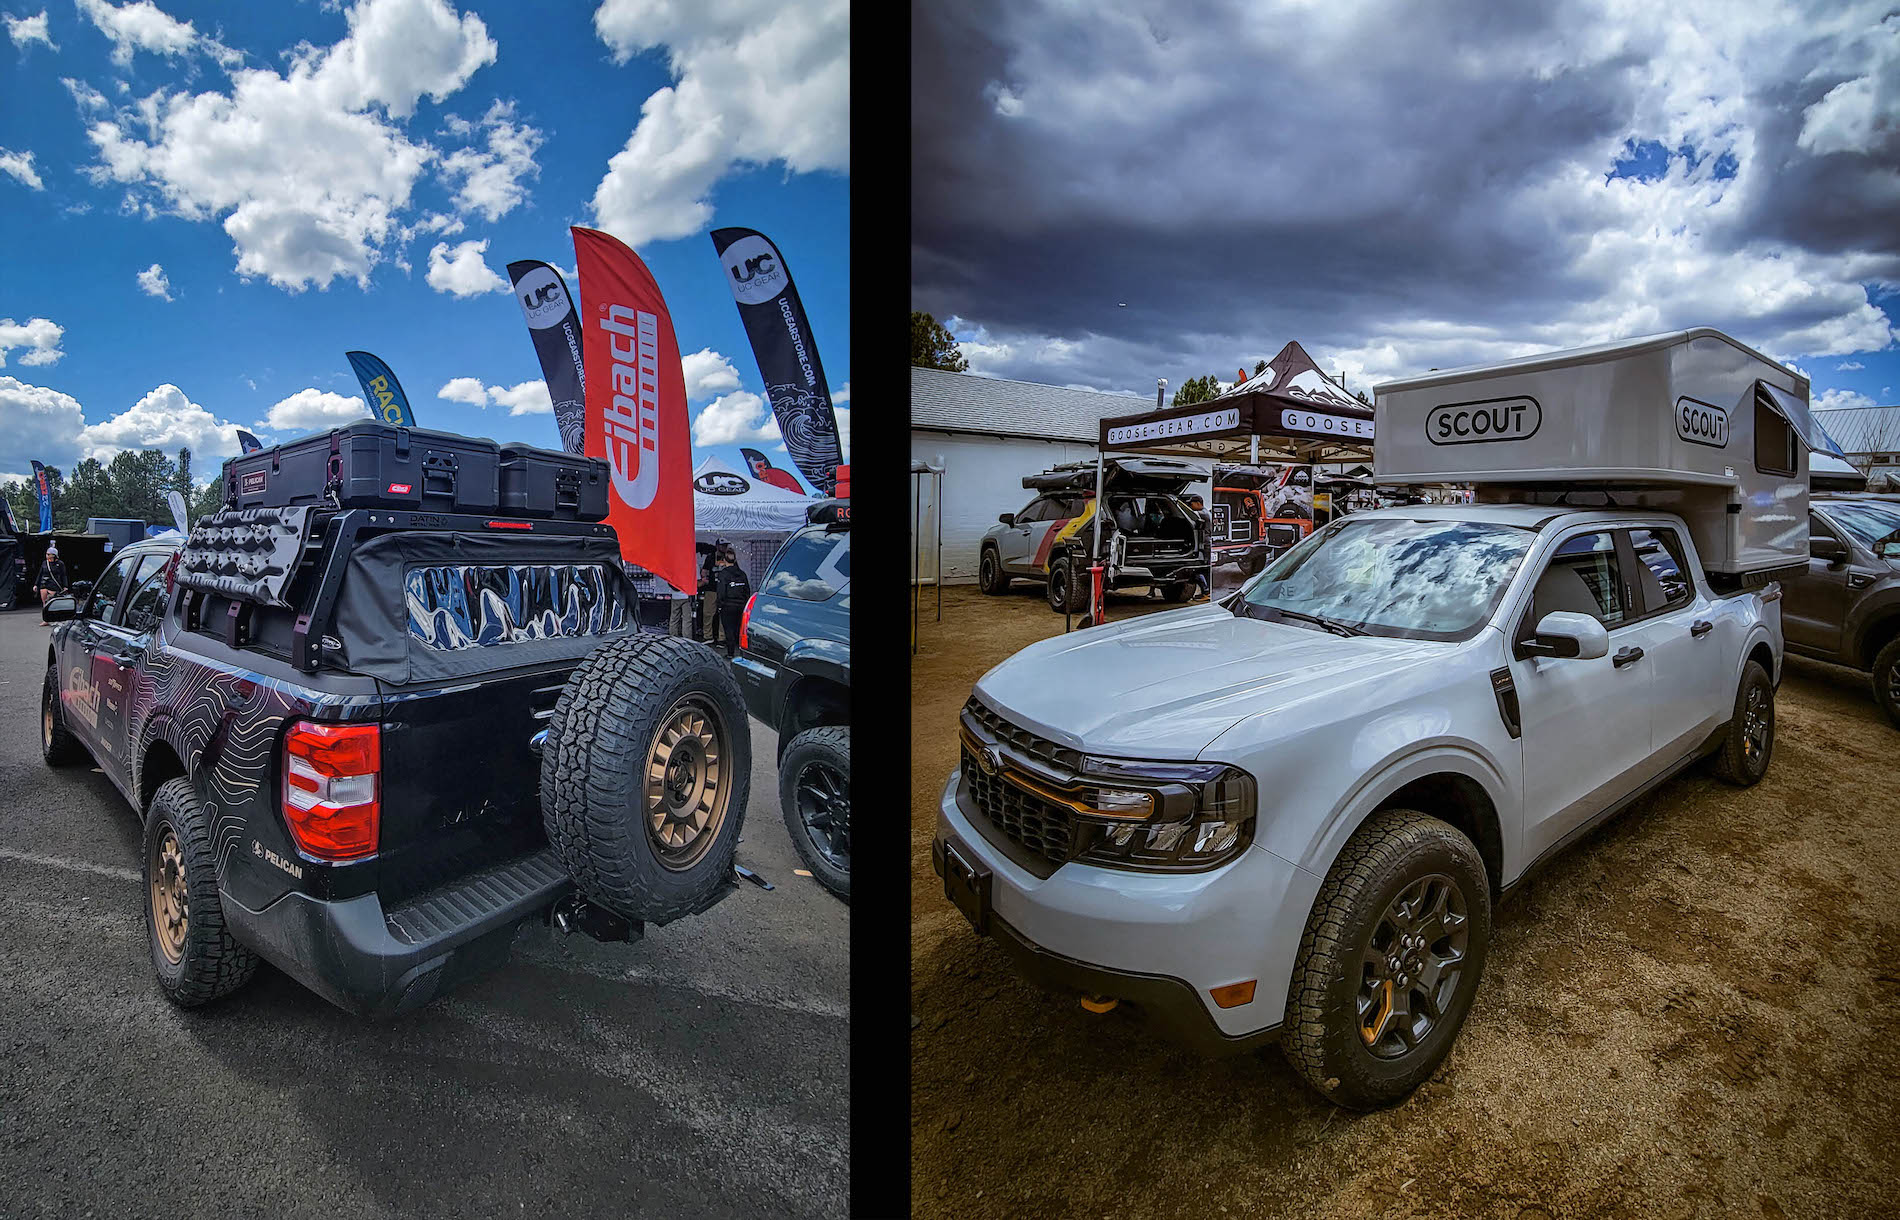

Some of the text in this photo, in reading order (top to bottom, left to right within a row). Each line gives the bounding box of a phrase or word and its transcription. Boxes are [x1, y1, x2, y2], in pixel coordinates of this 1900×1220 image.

[730, 252, 776, 284] UC
[737, 271, 781, 293] UC GEAR
[523, 282, 561, 311] UC
[528, 299, 564, 319] UC GEAR
[778, 297, 817, 387] UCGEARSTORE.COM
[369, 374, 404, 425] RAC
[1110, 412, 1236, 441] GOOSE-GEAR.COM
[1437, 405, 1527, 438] SCOUT
[1682, 406, 1724, 441] SCOUT
[698, 475, 744, 489] UC
[264, 849, 303, 880] PELICAN
